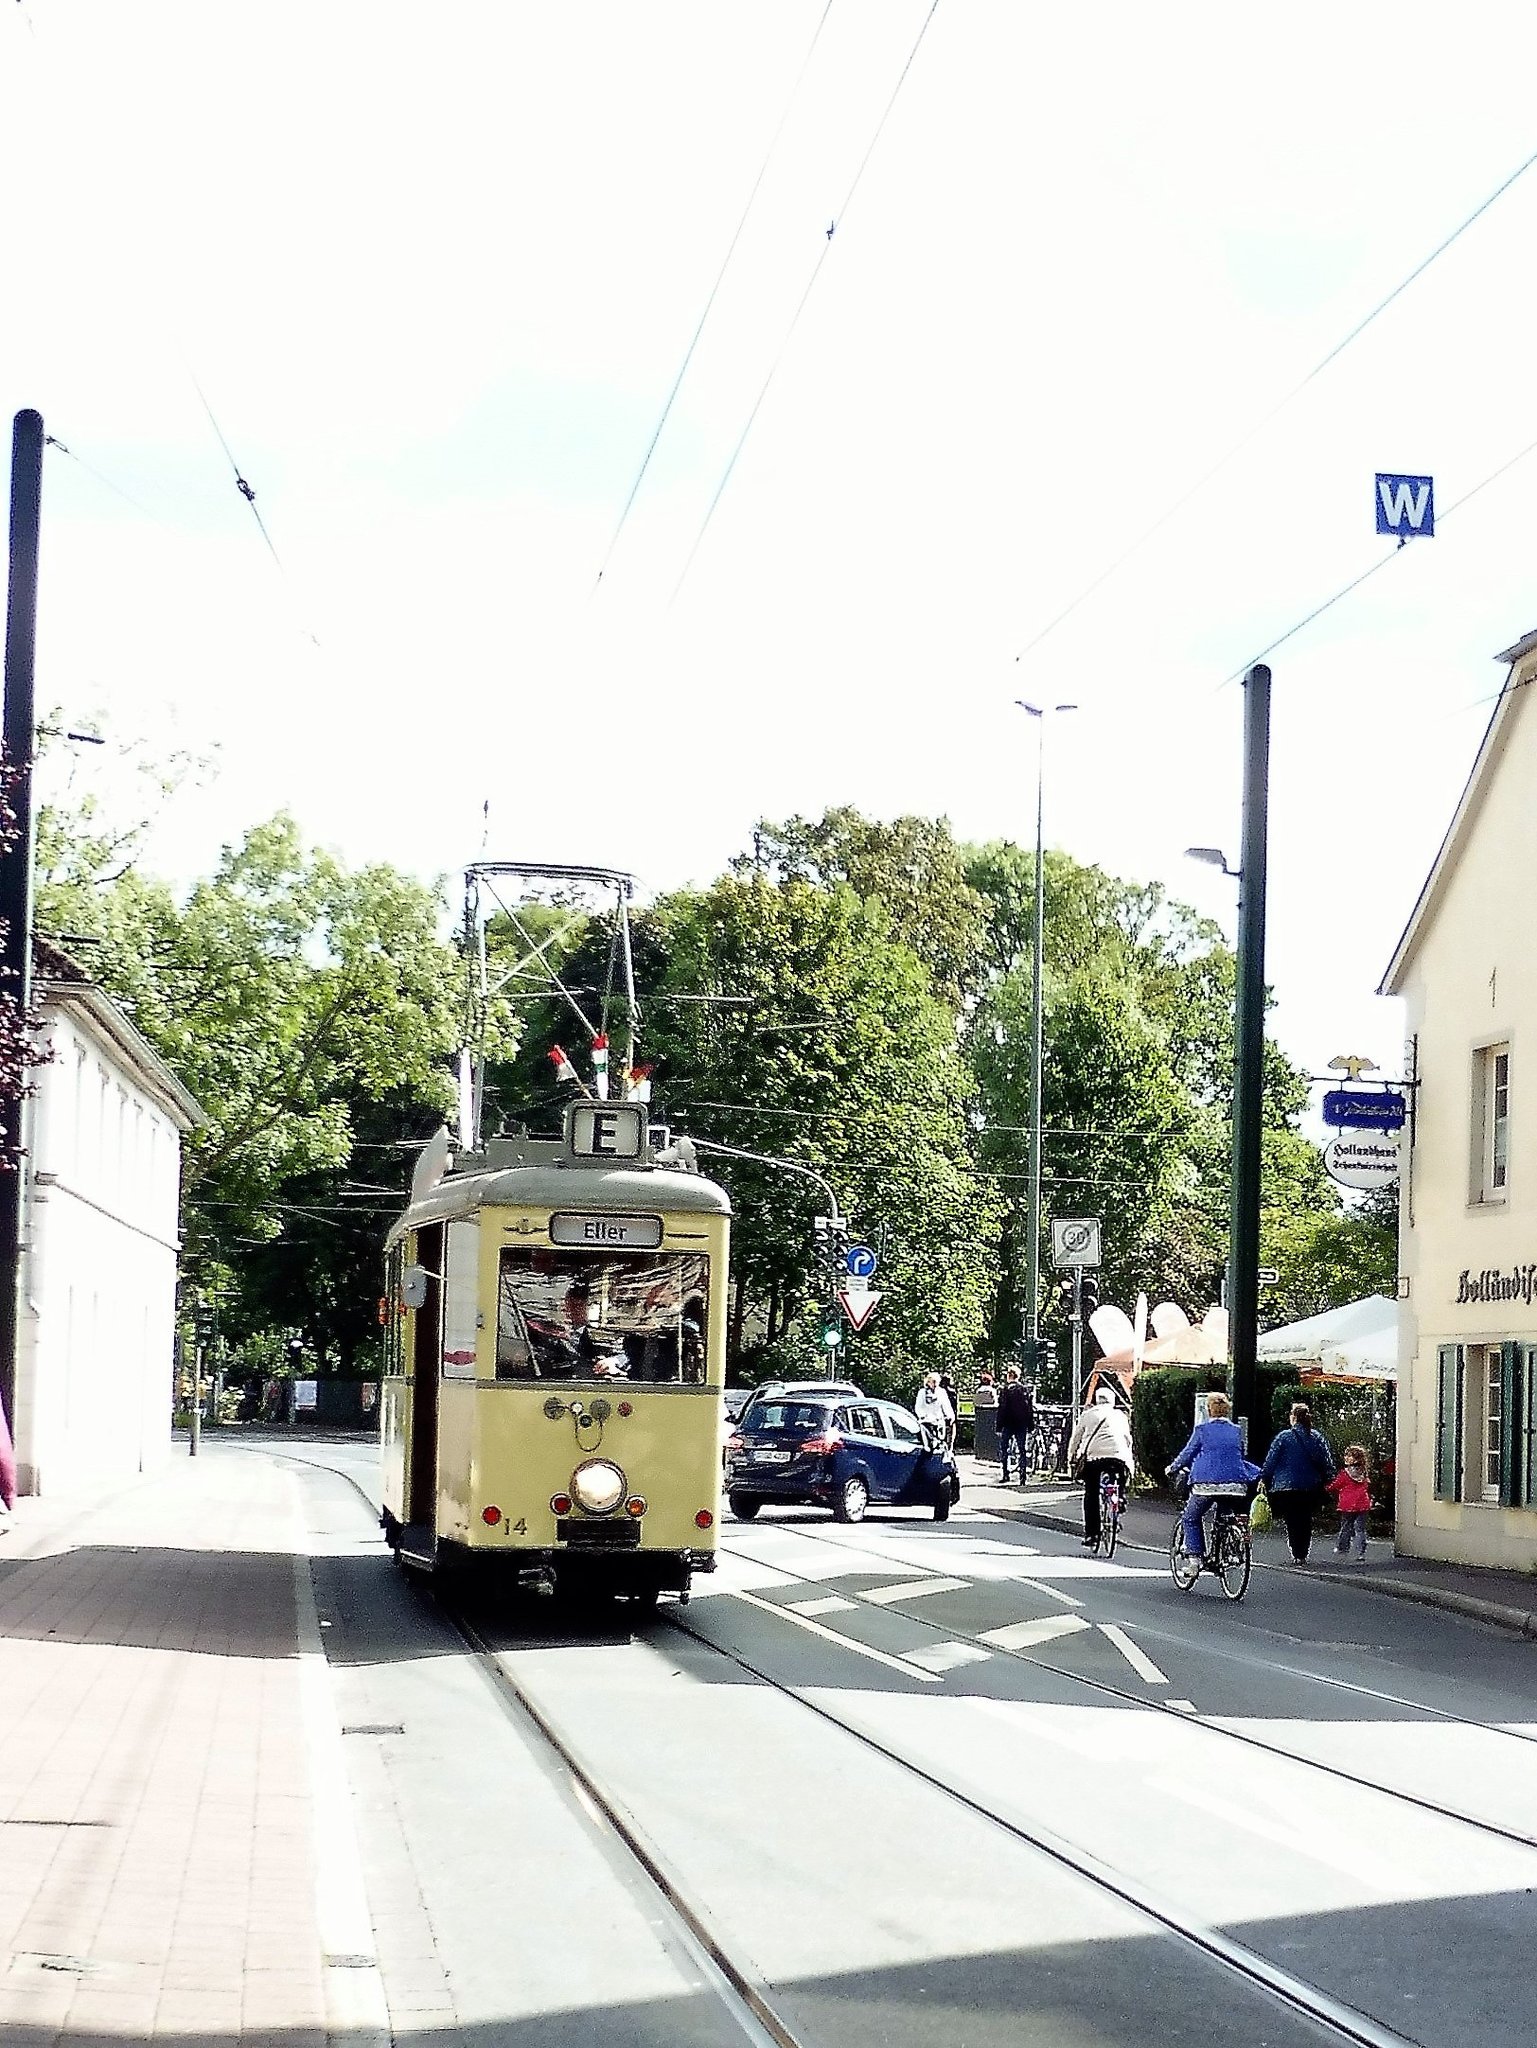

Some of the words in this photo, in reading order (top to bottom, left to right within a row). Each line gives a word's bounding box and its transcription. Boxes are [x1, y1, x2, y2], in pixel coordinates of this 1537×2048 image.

[1378, 481, 1430, 528] W
[592, 1112, 618, 1153] E
[584, 1222, 627, 1240] Eller
[1067, 1231, 1086, 1245] 30
[504, 1517, 528, 1536] 14
